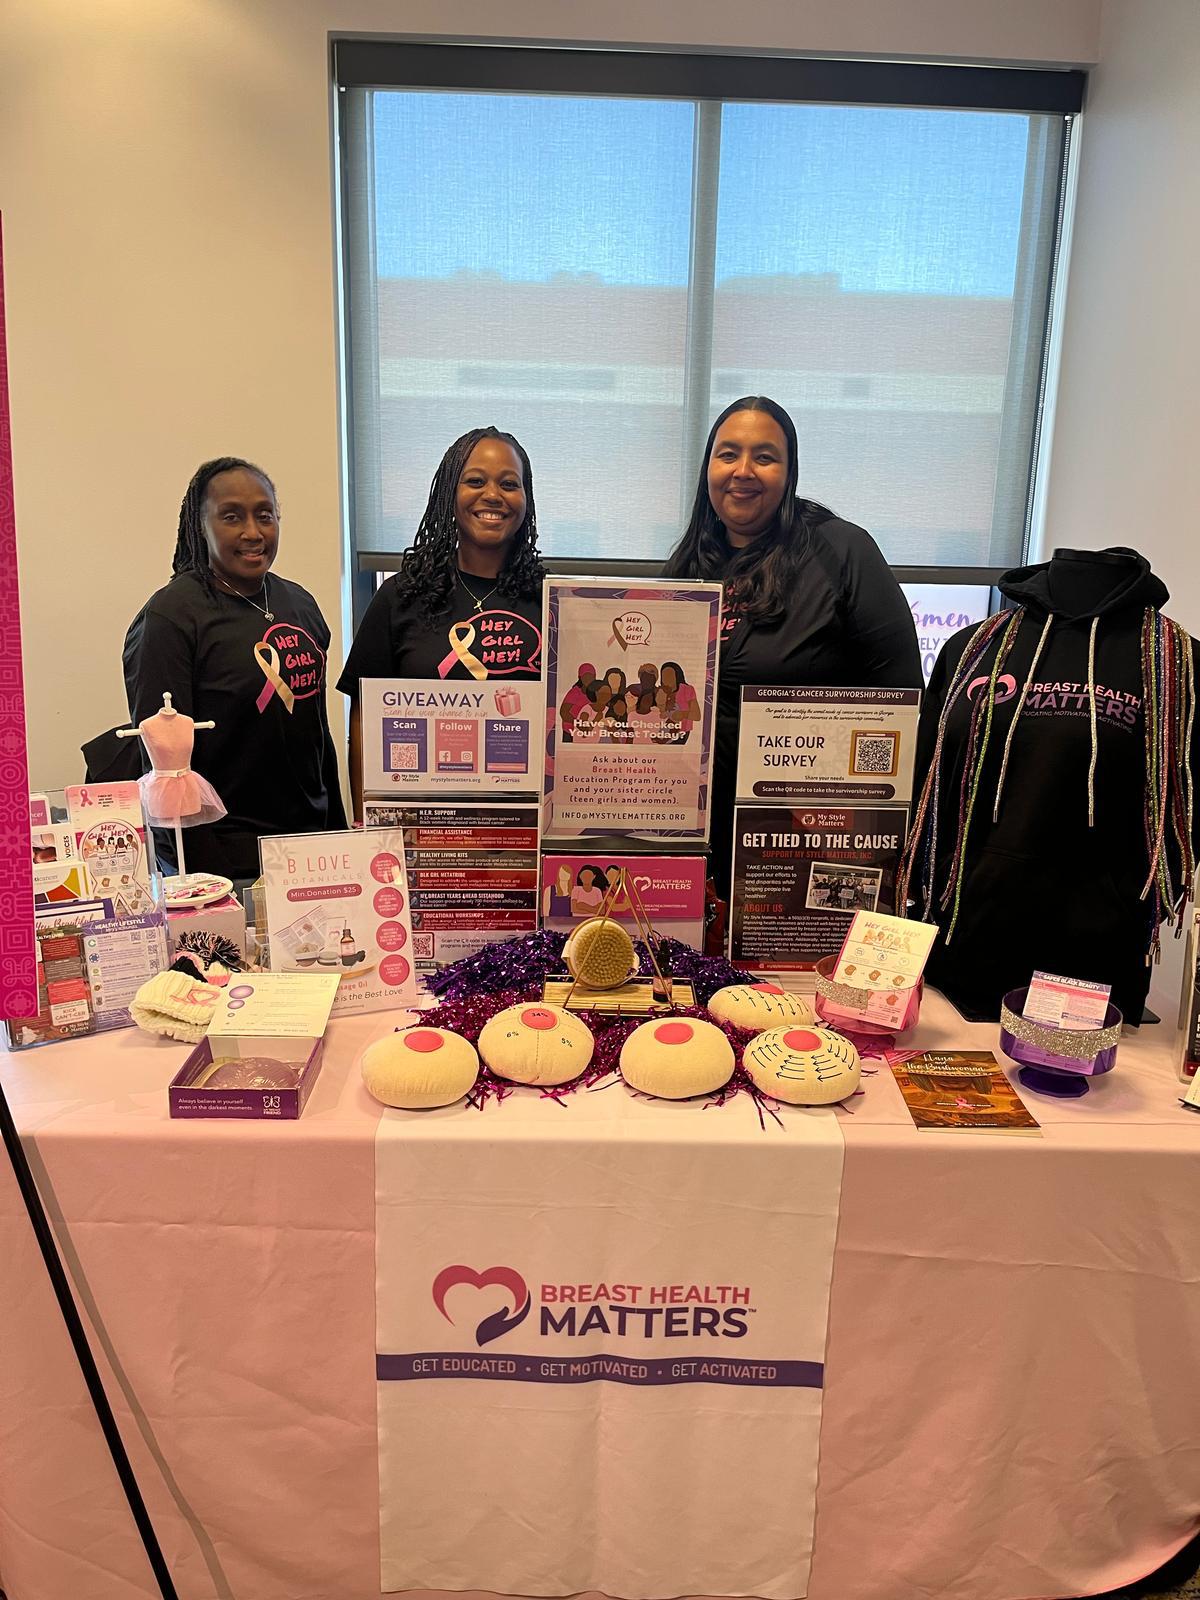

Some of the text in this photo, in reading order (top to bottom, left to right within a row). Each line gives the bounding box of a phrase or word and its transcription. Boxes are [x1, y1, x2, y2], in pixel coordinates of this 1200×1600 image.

[480, 620, 514, 632] HEY
[275, 635, 299, 650] HEY
[481, 635, 524, 647] GIRL
[285, 652, 316, 669] GIRL
[482, 649, 521, 663] HEY!
[291, 670, 316, 689] HEY!
[758, 689, 796, 697] GEORGIA'S
[796, 690, 824, 698] CANCER
[1023, 683, 1142, 709] BREAST HEALTH
[383, 692, 485, 708] GIVEAWAY
[1024, 693, 1137, 725] MATTERS
[393, 721, 417, 729] Scan
[440, 722, 472, 731] Follow
[493, 724, 521, 732] Share
[573, 719, 682, 729] Have You Checked
[1098, 716, 1134, 734] ACTIVATING
[569, 728, 686, 740] Your Breast Today?
[757, 736, 825, 749] TAKE OUR
[593, 756, 609, 764] Ask
[612, 756, 638, 764] about
[763, 755, 817, 767] SURVEY
[613, 777, 651, 785] Program
[672, 778, 688, 786] you
[617, 786, 644, 794] sister
[569, 795, 679, 805] (teen girls and women).
[561, 812, 686, 820] INFO@MYSTYLEMATTERS.ORG
[742, 833, 898, 849] GET TIED TO THE CAUSE
[288, 854, 351, 873] B LOVE
[283, 873, 364, 886] BOTANICALS
[744, 904, 783, 912] ABOUT US
[95, 921, 118, 929] HEALTHY
[119, 918, 145, 927] LIFESTYLE
[1079, 981, 1100, 989] BEAUTY
[541, 1284, 751, 1305] BREAST HEALTH
[412, 1359, 777, 1380] GET EDUCATED GET MOTIVATED GET ACTIVATED
